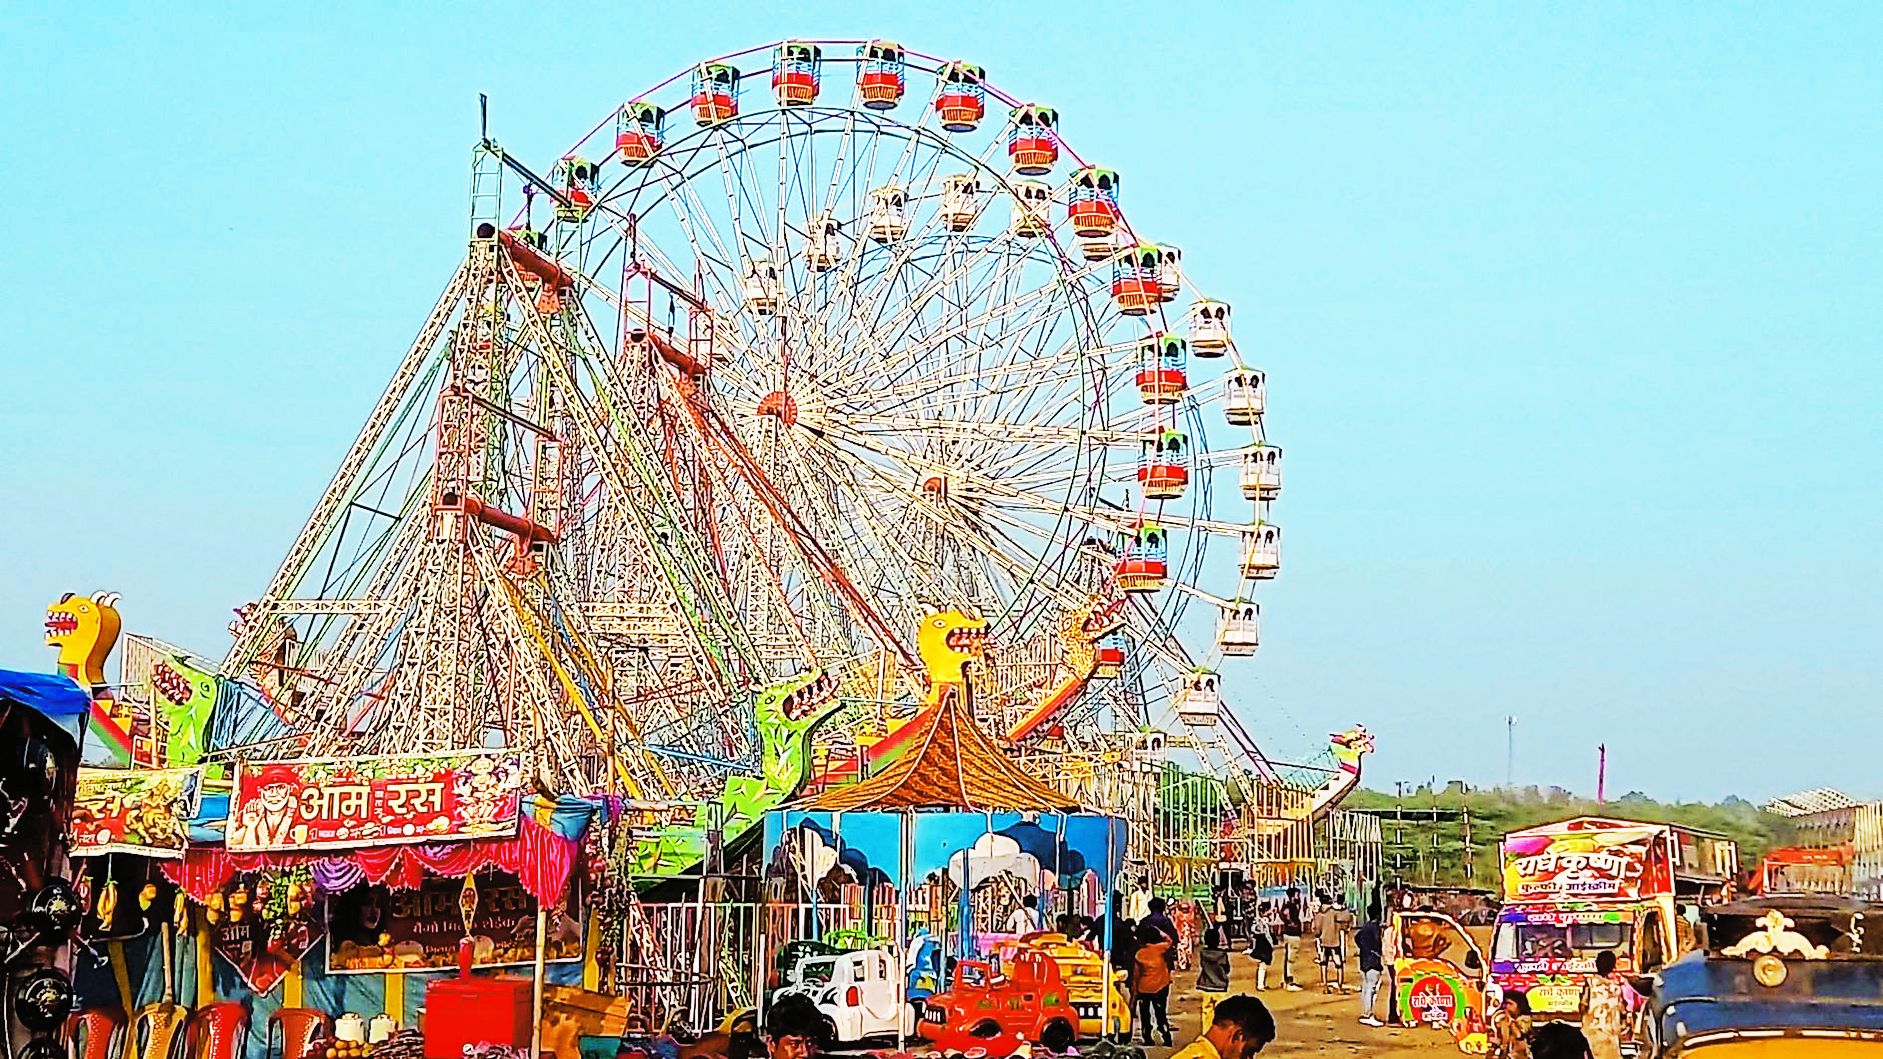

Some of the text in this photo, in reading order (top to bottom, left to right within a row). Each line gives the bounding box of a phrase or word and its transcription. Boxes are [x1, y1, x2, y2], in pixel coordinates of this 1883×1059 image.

[300, 785, 371, 820] आम
[386, 782, 445, 814] रस
[1516, 851, 1627, 879] राधे कृष्णा
